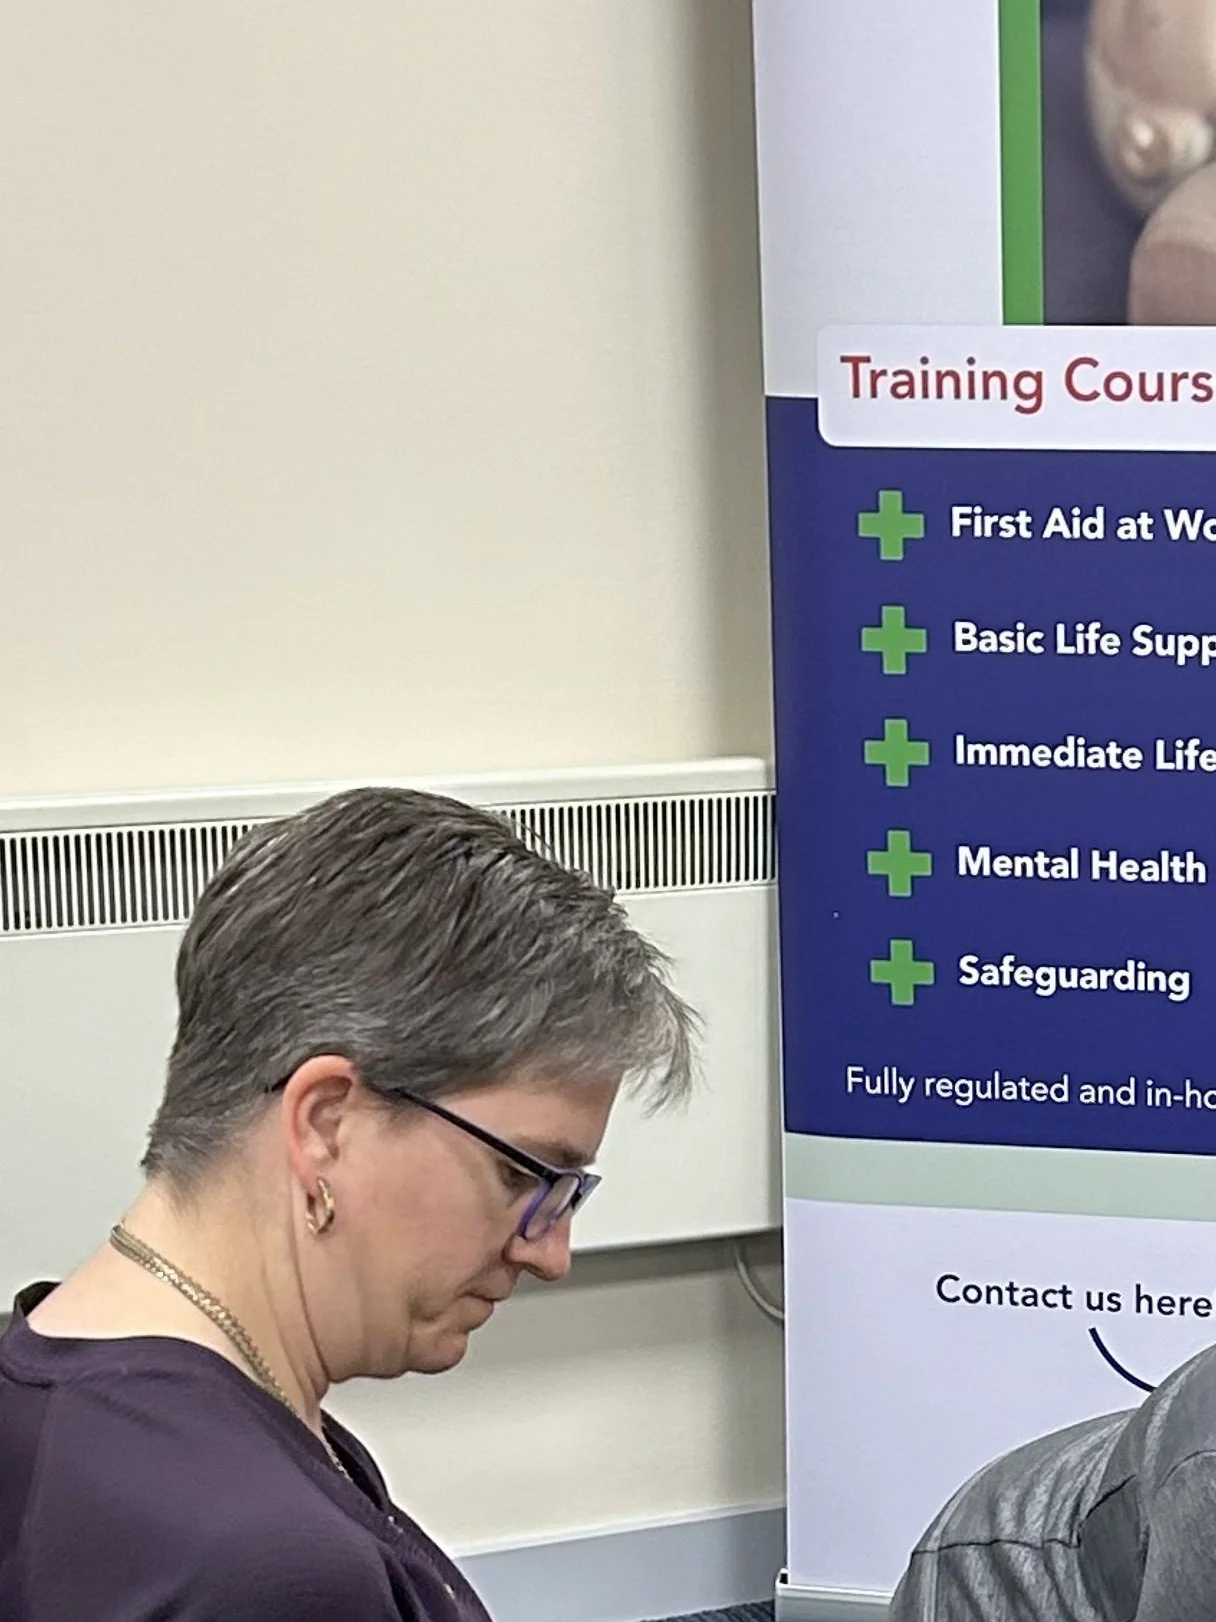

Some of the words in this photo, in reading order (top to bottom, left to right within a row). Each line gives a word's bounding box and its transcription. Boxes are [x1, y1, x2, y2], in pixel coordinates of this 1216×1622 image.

[839, 355, 1043, 415] Training
[951, 505, 1033, 539] First
[1042, 506, 1105, 540] Aid
[1116, 511, 1154, 541] at
[954, 621, 1045, 654] Basic
[1056, 621, 1121, 656] Life
[955, 734, 1143, 770] Immediate
[958, 845, 1079, 879] Mental
[1091, 849, 1206, 883] Health
[959, 954, 1190, 1002] Safeguarding
[847, 1066, 915, 1104] Fully
[925, 1070, 1069, 1106] regulated
[1079, 1076, 1136, 1106] and
[936, 1274, 1073, 1310] Contact
[1086, 1290, 1122, 1313] us
